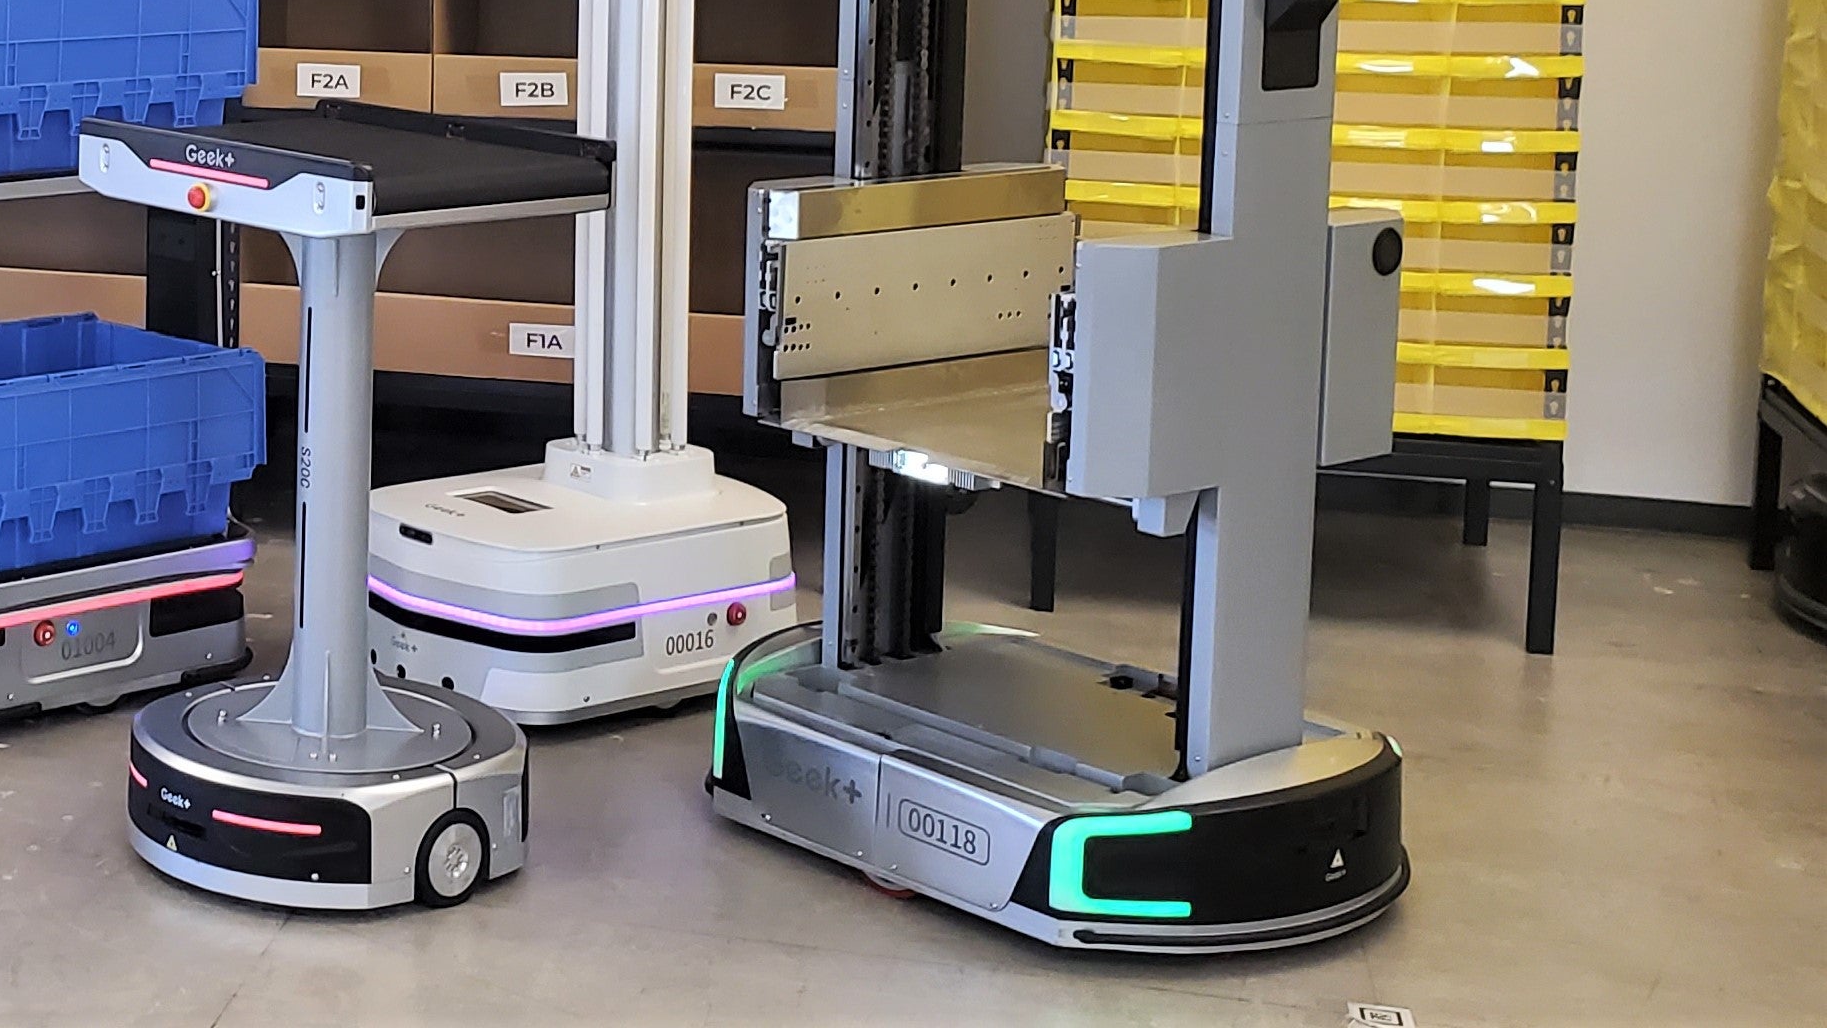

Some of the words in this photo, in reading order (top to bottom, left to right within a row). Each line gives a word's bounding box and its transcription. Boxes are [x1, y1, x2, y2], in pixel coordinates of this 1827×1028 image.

[312, 74, 348, 89] F2A
[516, 83, 554, 97] F2B
[731, 84, 770, 100] F2C
[185, 144, 235, 168] Geek+
[527, 333, 562, 350] F1A
[300, 446, 311, 489] S20C
[61, 632, 116, 660] 01004
[666, 629, 714, 656] 00016
[160, 787, 191, 809] Geek+
[908, 807, 976, 855] 00118
